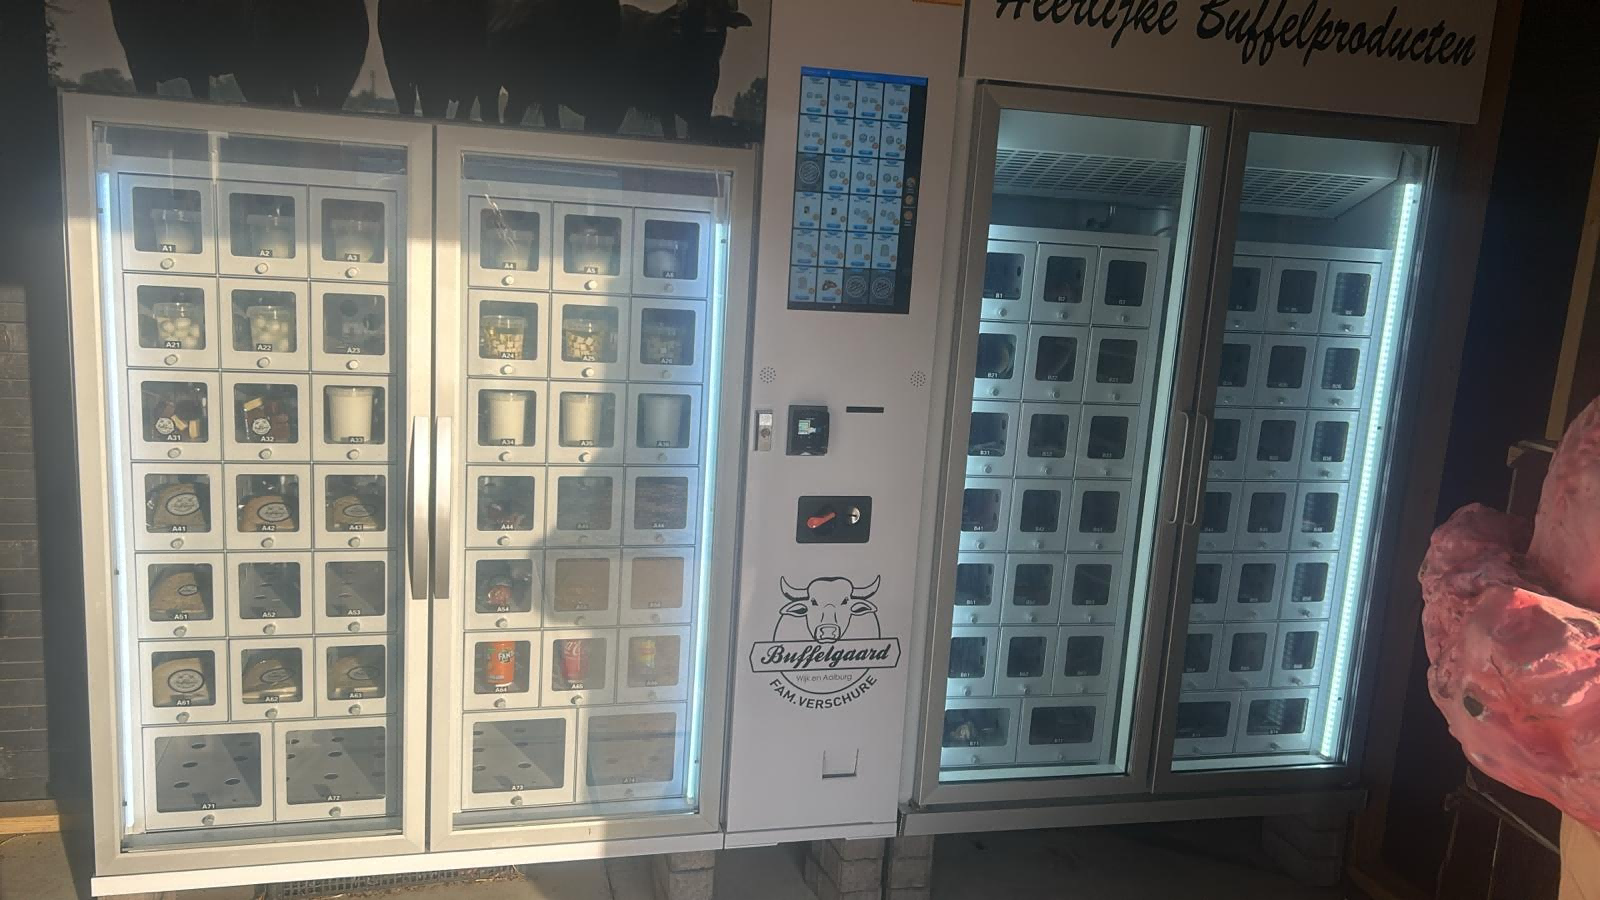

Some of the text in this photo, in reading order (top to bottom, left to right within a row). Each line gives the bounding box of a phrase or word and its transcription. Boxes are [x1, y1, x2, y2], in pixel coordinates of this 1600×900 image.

[1197, 0, 1476, 67] Buffelproducten
[761, 644, 891, 669] Buffelgaard
[769, 674, 877, 709] FAM.VERSCHURE
